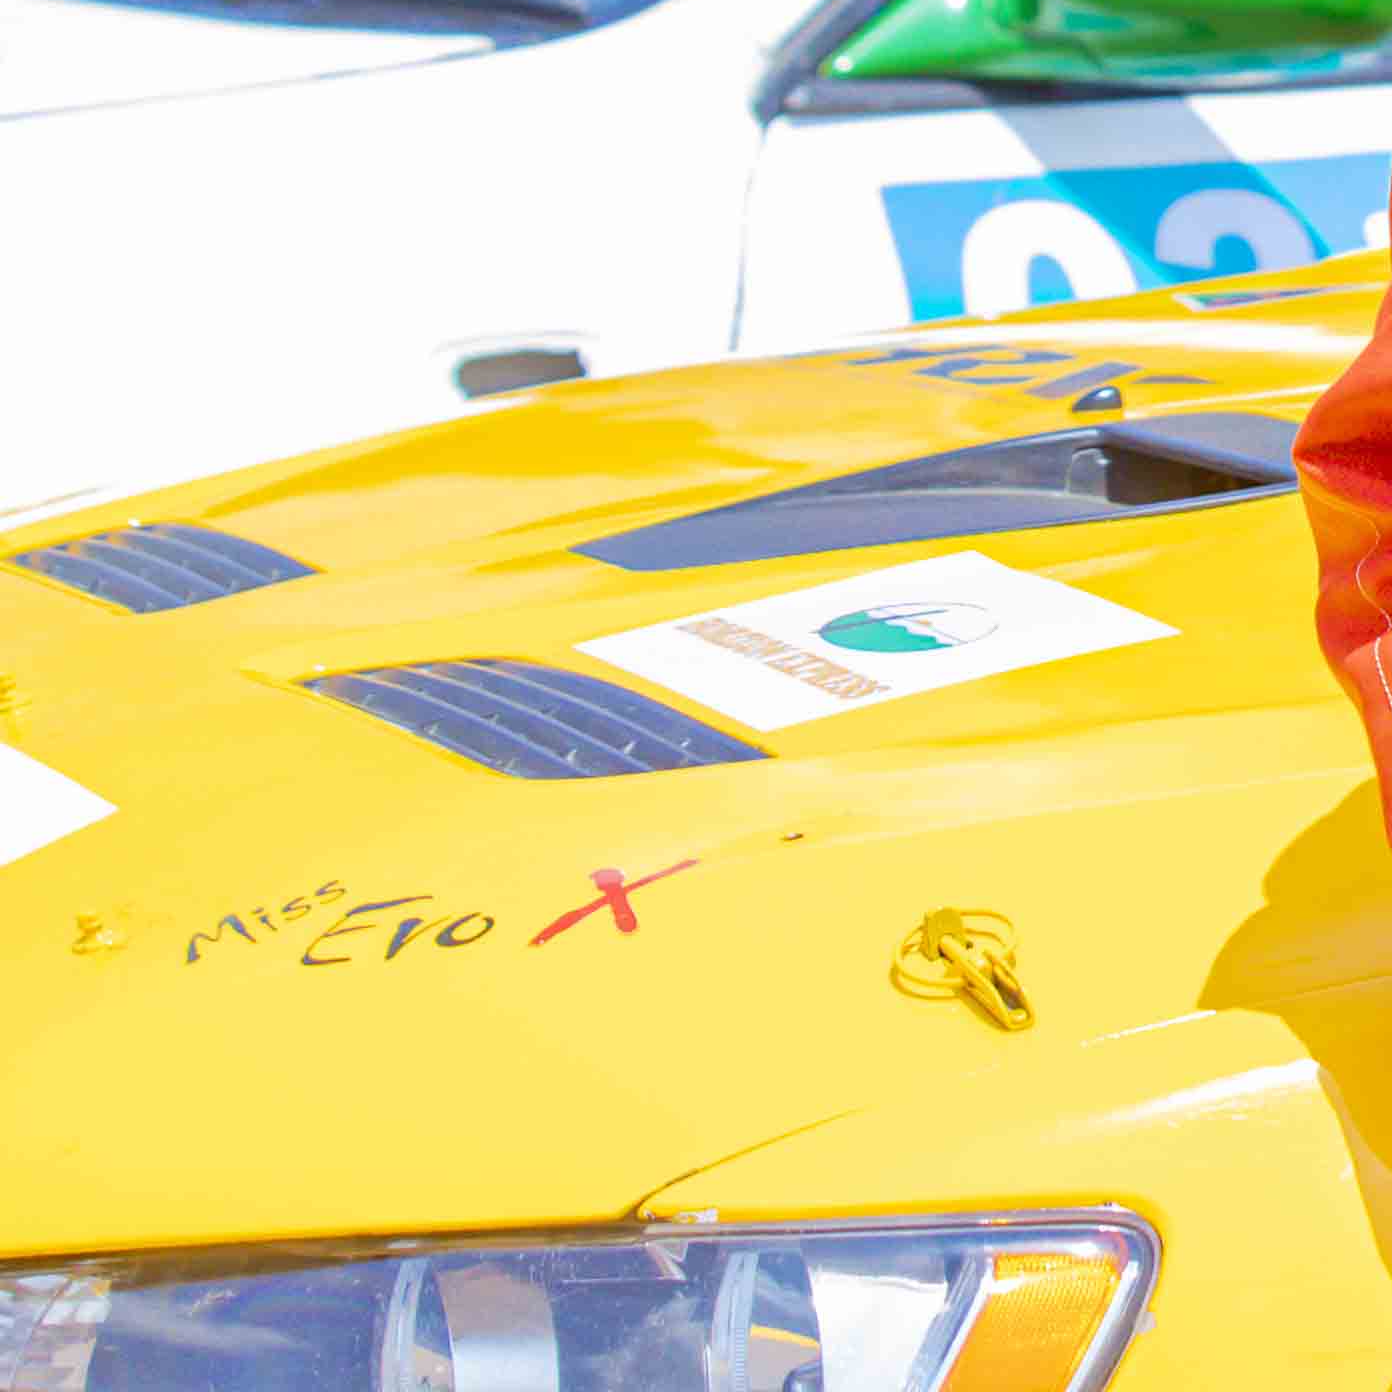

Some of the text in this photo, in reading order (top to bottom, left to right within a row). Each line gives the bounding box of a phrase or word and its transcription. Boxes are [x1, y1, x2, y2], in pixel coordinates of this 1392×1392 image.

[185, 858, 703, 967] Miss Evo X
